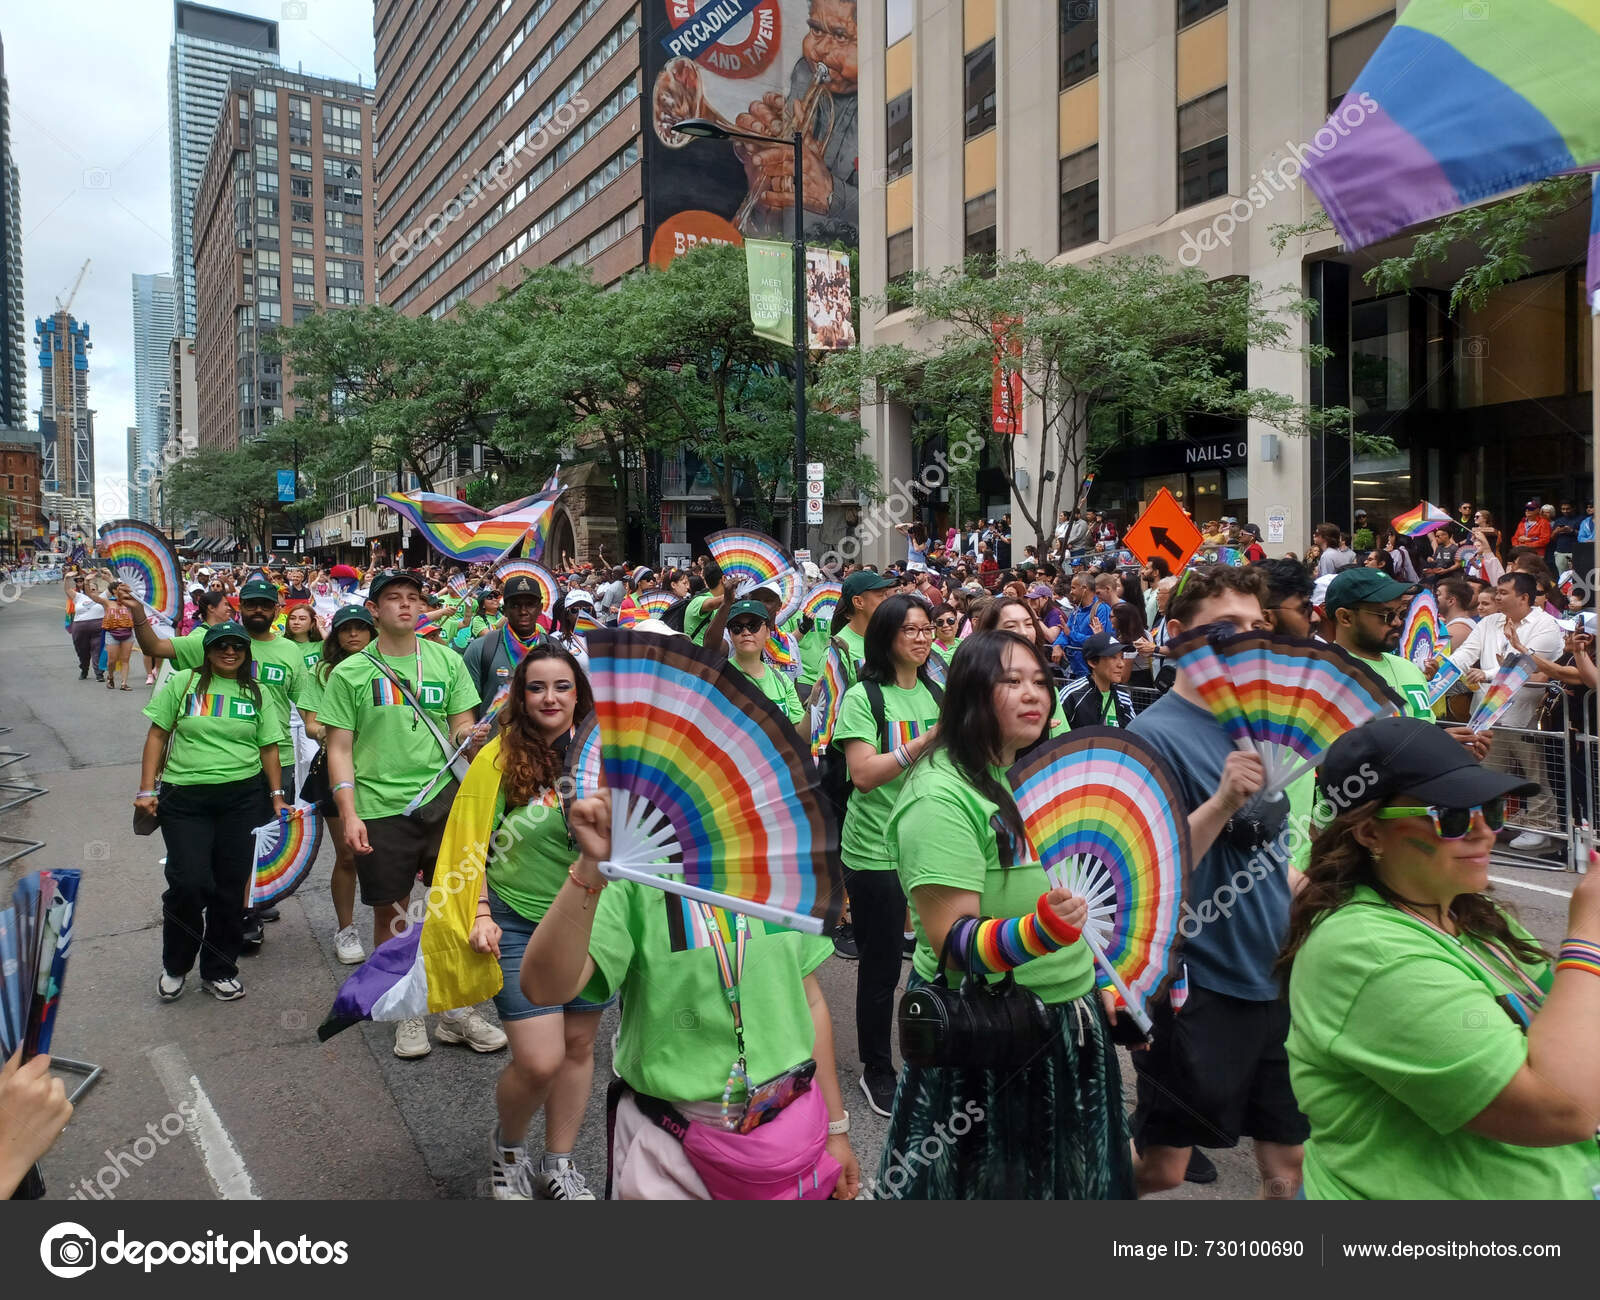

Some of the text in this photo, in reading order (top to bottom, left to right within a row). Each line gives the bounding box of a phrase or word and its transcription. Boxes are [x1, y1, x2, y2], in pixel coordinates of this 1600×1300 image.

[669, 0, 743, 56] PICCADILLY
[708, 8, 773, 71] AND TAVERN
[1186, 443, 1232, 463] NAILS
[352, 537, 365, 545] 40
[264, 666, 284, 681] TD
[422, 686, 443, 704] TD
[233, 702, 255, 716] TD
